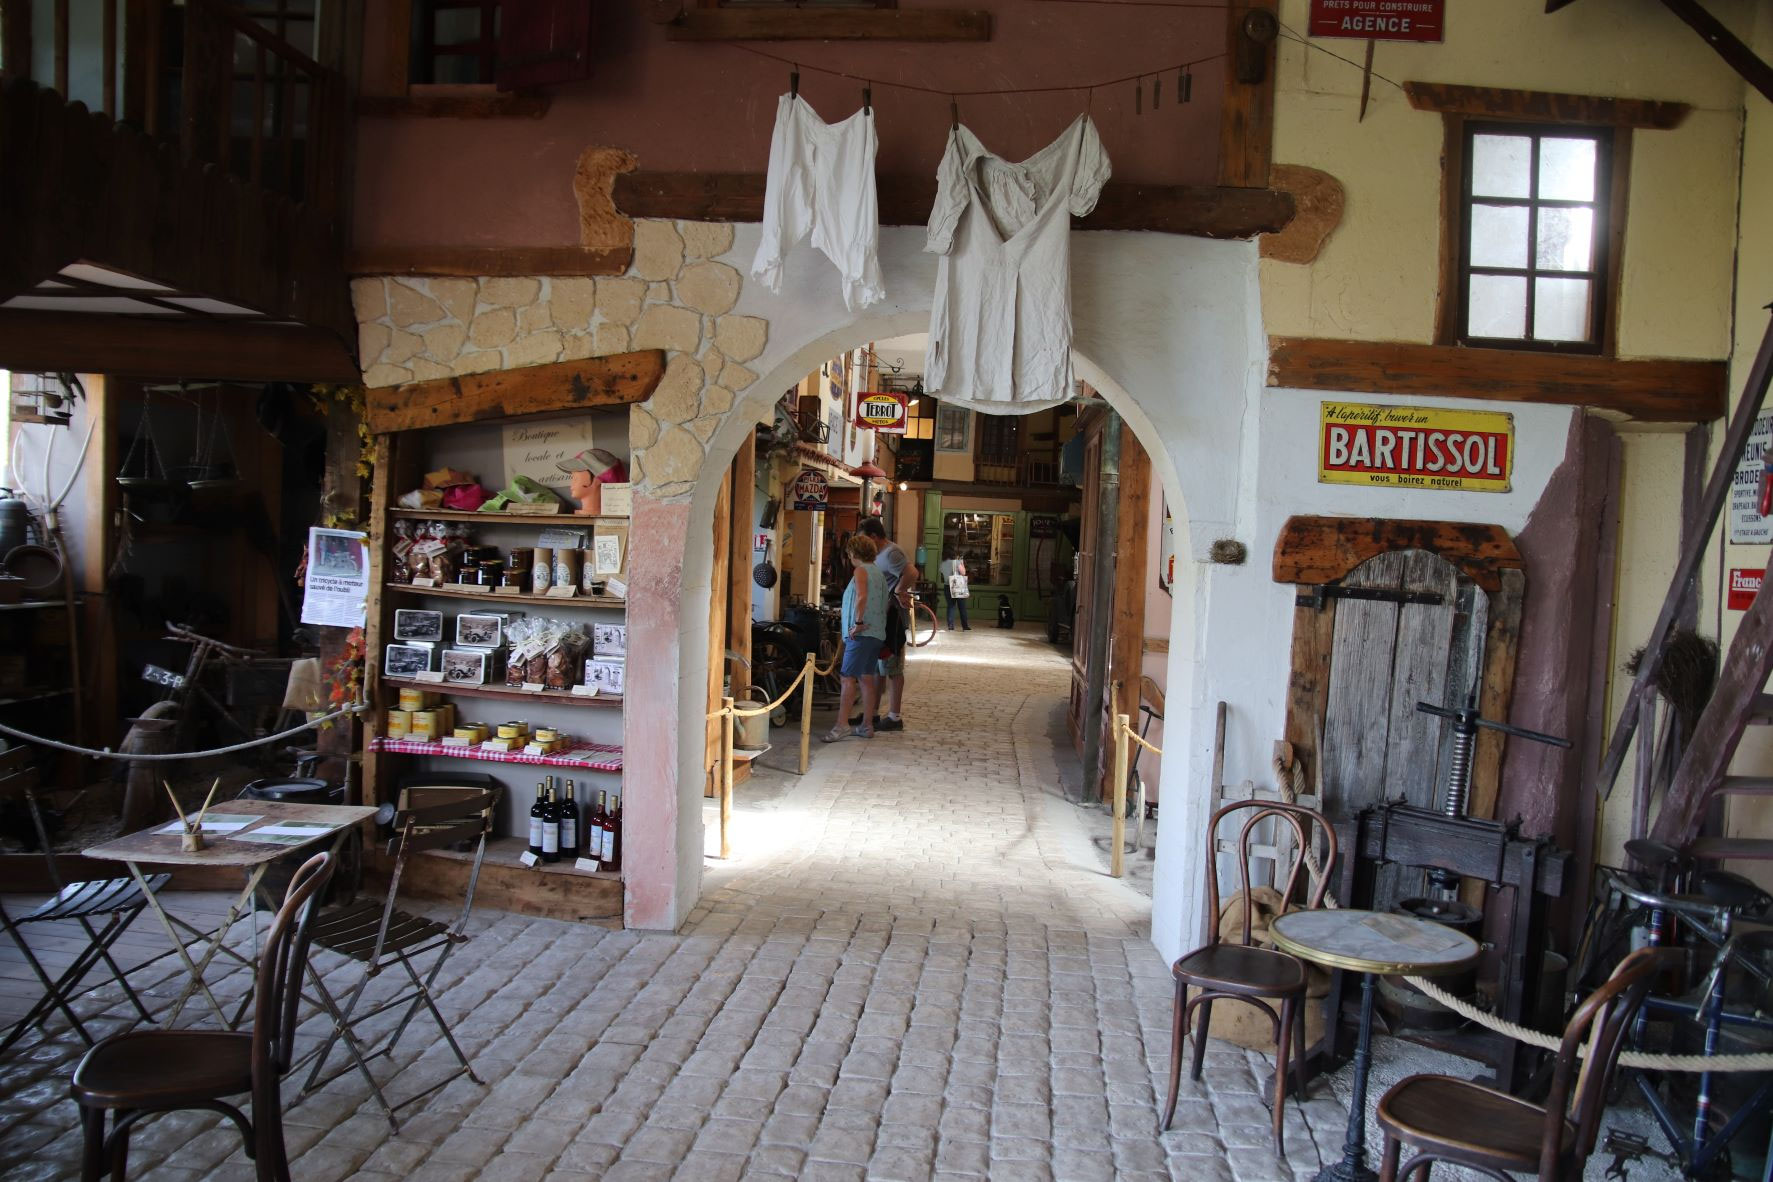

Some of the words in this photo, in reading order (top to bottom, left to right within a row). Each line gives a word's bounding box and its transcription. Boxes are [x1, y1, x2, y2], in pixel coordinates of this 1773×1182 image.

[1380, 2, 1433, 12] CONSTRUIRE
[1341, 16, 1411, 32] AGENCE
[864, 403, 898, 418] TERROT
[1414, 415, 1429, 424] un
[512, 427, 559, 443] Boutique
[524, 449, 551, 463] locale
[556, 450, 564, 459] et
[1329, 427, 1501, 476] BARTISSOL
[538, 473, 573, 482] artisan
[1370, 475, 1390, 483] vous
[1398, 474, 1425, 485] boirez
[1430, 477, 1462, 487] naturel
[1735, 469, 1760, 485] BRODE
[799, 484, 823, 493] MAZDA
[319, 577, 338, 585] tricycle
[1732, 570, 1761, 588] Franc
